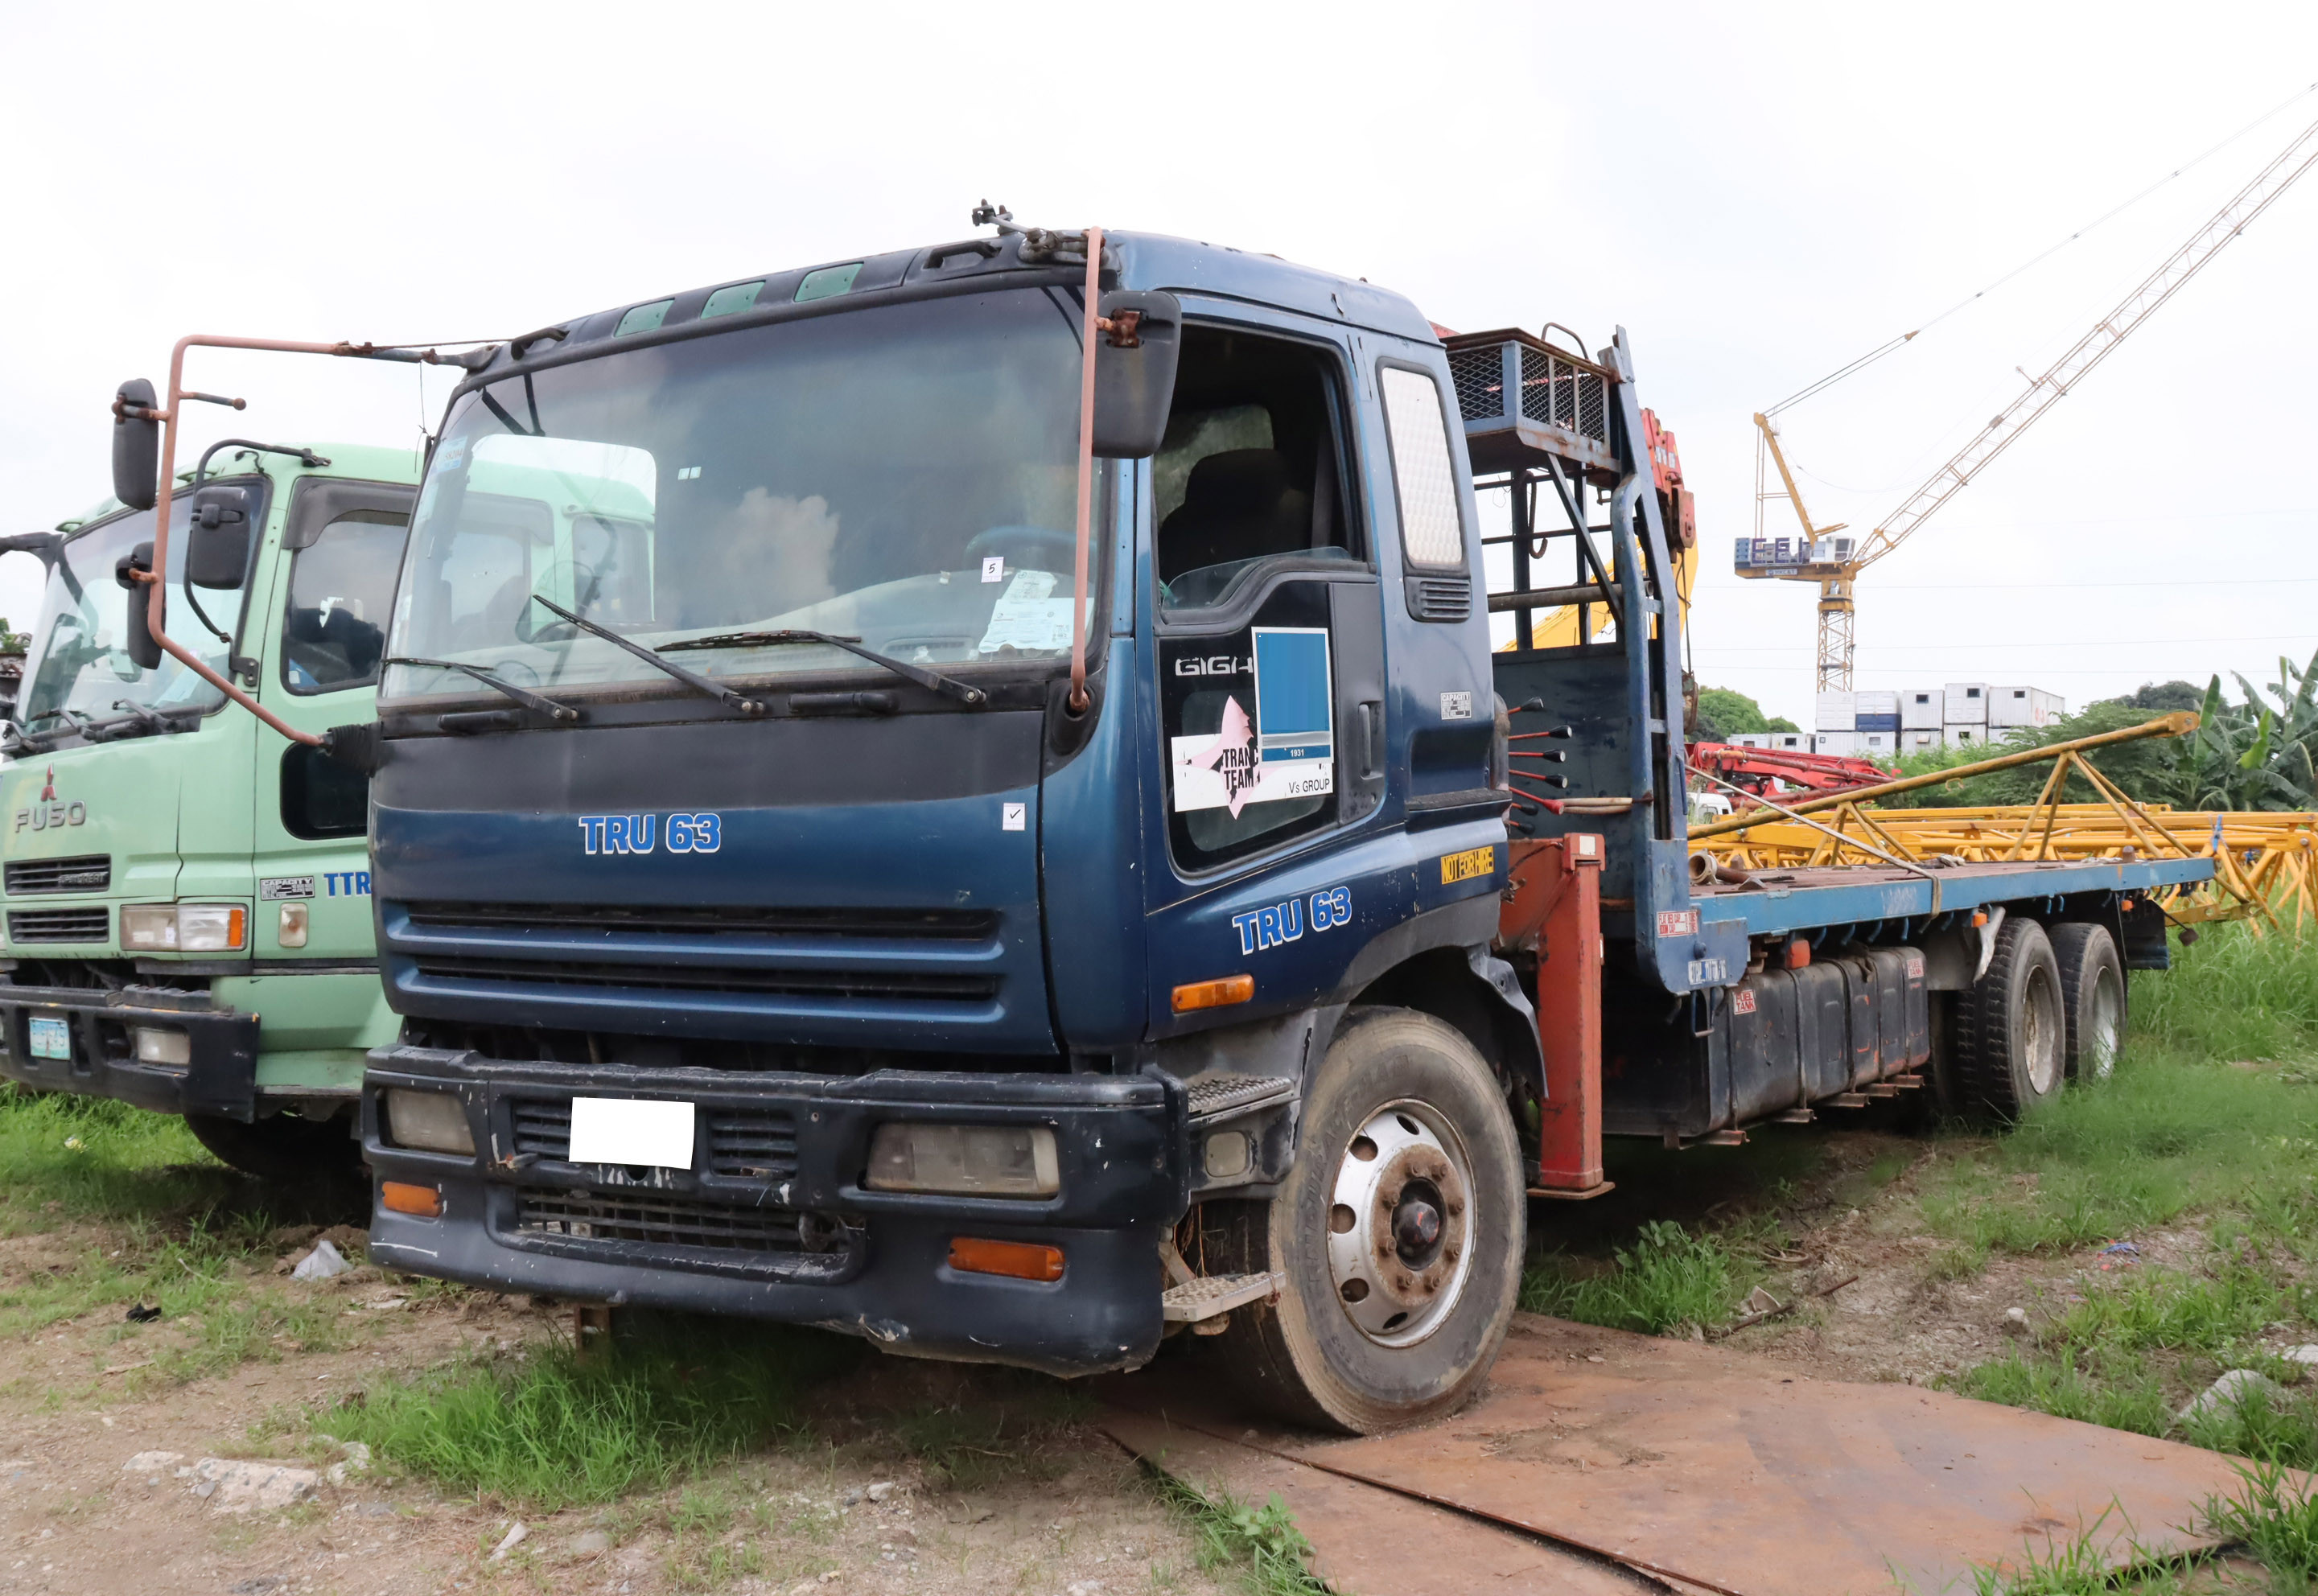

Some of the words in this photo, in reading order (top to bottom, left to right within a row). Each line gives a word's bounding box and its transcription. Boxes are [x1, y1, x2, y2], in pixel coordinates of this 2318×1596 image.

[988, 563, 997, 574] 5
[1442, 693, 1470, 701] CAPACITY
[1290, 748, 1304, 758] 1931
[1223, 767, 1254, 791] TEAM
[1302, 778, 1330, 792] GROUP
[15, 800, 87, 833] FUSO
[578, 814, 656, 855] TRU
[665, 812, 722, 854] 63
[1442, 854, 1459, 882] NOT
[1459, 853, 1475, 878] FOR
[1475, 847, 1494, 874] HIRE
[261, 878, 313, 886] CAPACITY
[1232, 898, 1304, 956] TRU
[1309, 886, 1353, 932] 63
[1736, 992, 1753, 1003] FUEL
[1737, 1002, 1756, 1011] TANK
